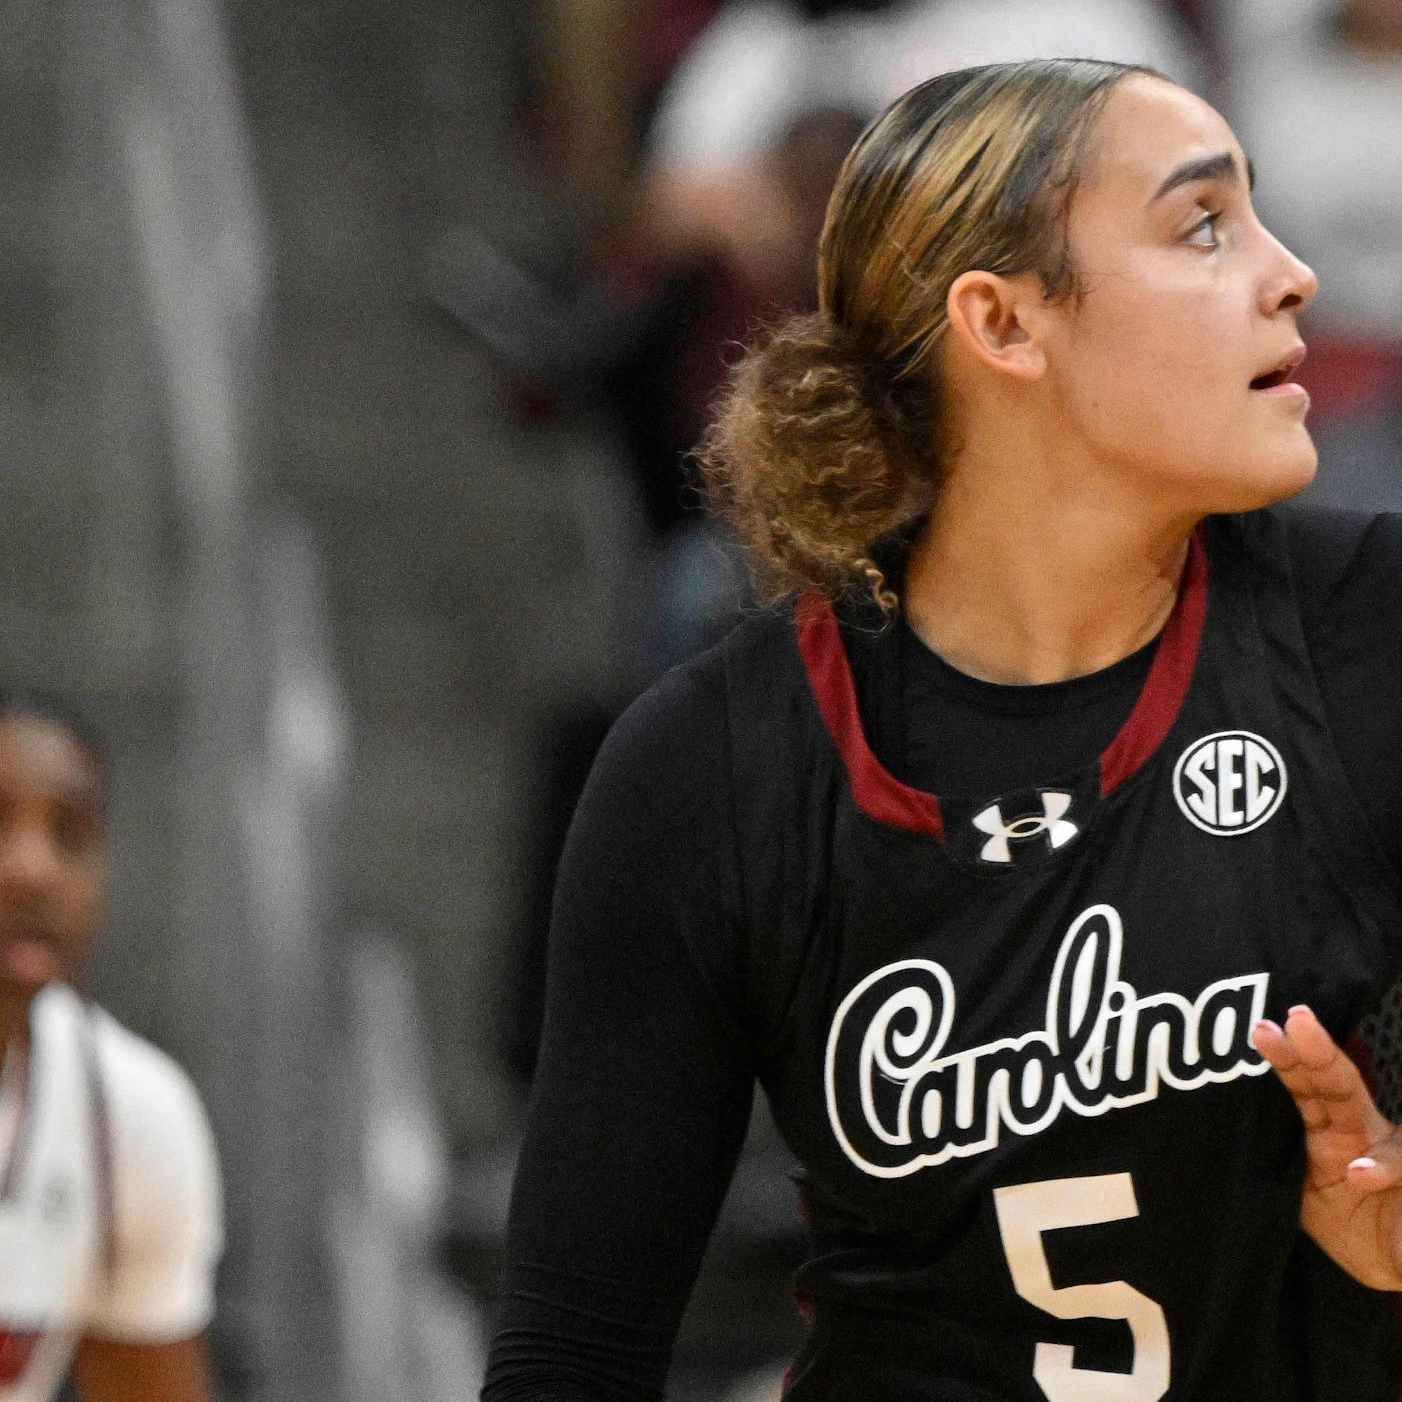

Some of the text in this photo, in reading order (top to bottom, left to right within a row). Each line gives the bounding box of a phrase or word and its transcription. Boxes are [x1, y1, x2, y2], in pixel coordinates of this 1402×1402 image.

[1184, 739, 1276, 826] SEC
[825, 904, 1272, 1179] Carolina
[992, 1172, 1171, 1402] 5
